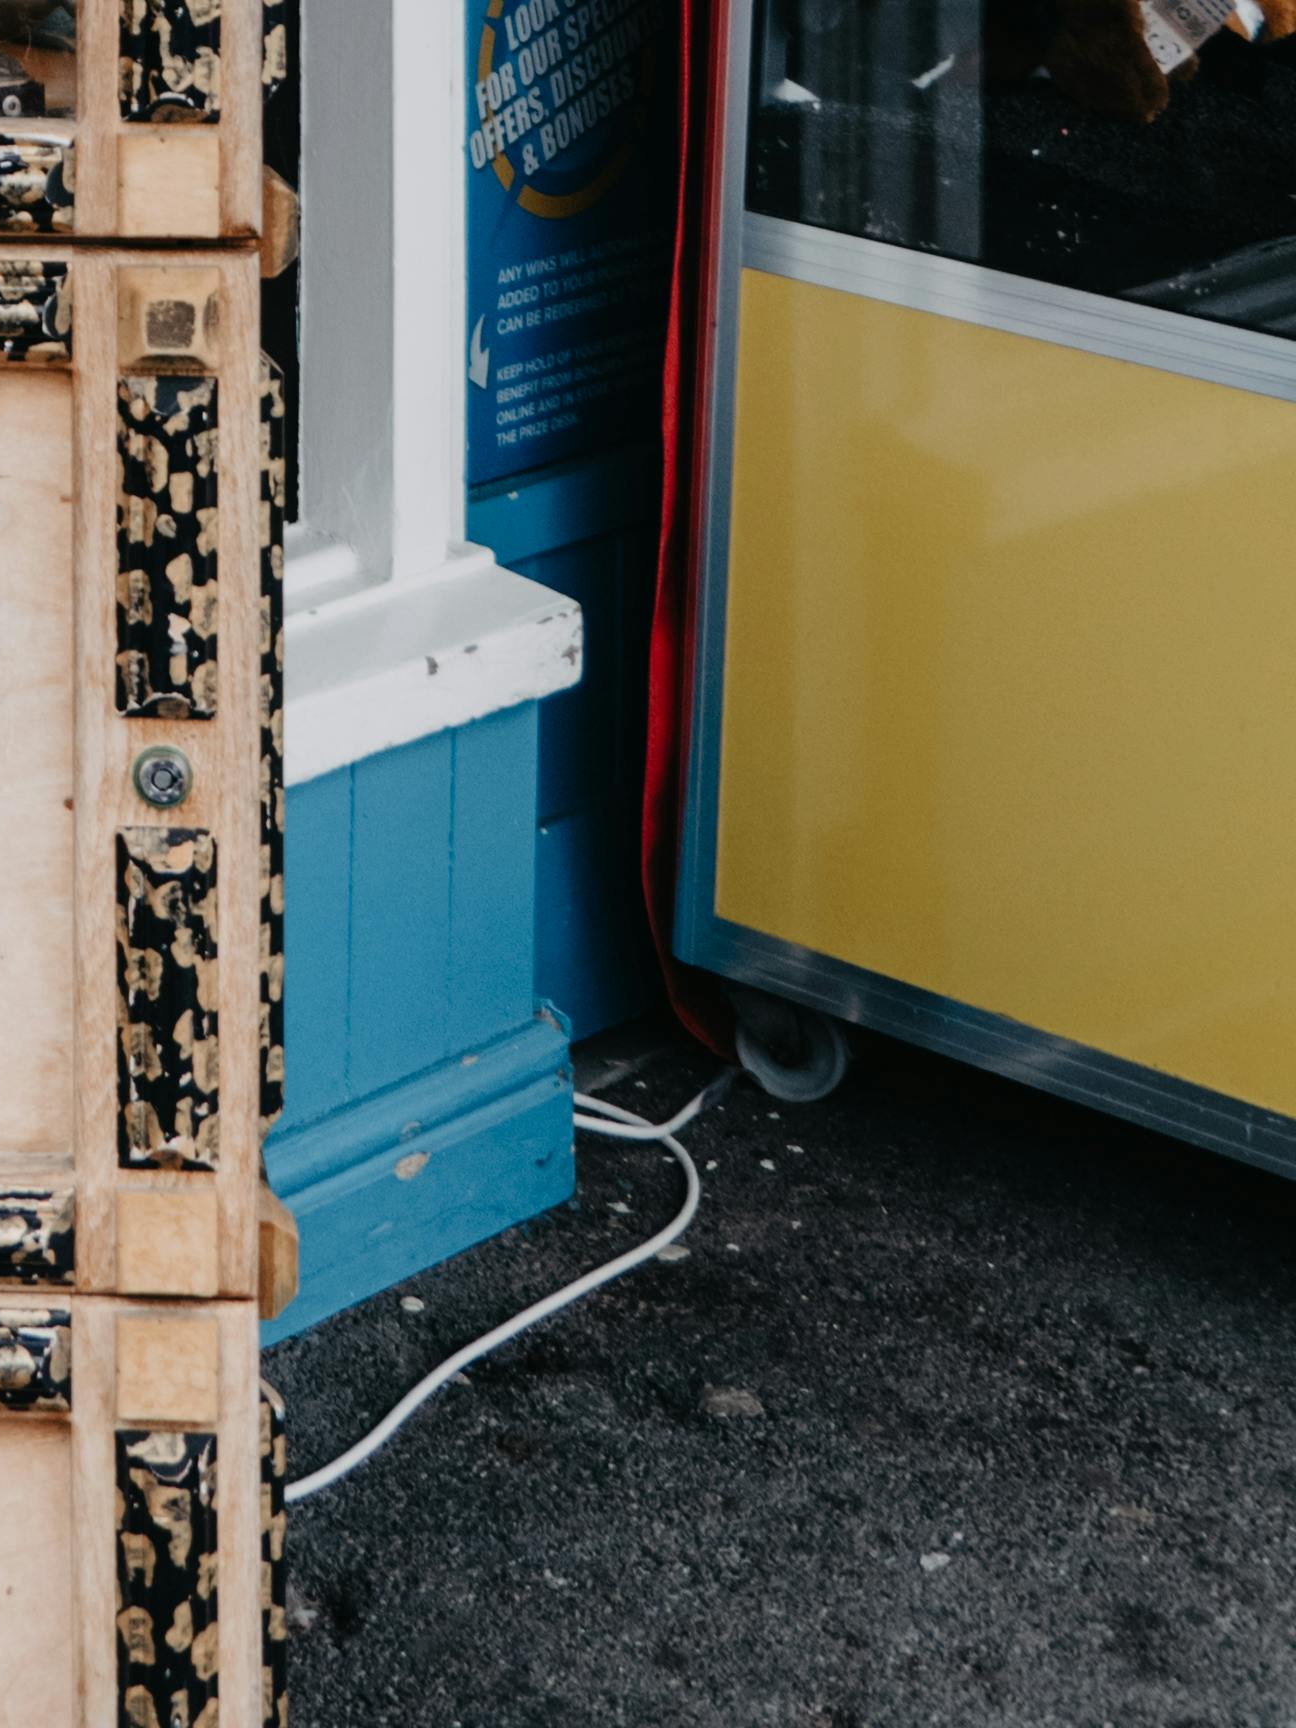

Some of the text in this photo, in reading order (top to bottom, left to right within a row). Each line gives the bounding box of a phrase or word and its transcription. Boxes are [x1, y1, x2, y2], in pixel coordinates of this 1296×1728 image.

[474, 60, 518, 123] FOR
[518, 27, 563, 86] OUR
[521, 63, 635, 176] & BONUSES
[497, 264, 523, 285] ANY
[525, 255, 557, 278] WINS
[497, 285, 539, 311] ADDED
[542, 279, 558, 298] TO
[497, 314, 524, 335] CAN
[525, 308, 542, 327] BE
[496, 362, 524, 382] KEEP
[525, 353, 556, 375] HOLD
[496, 378, 539, 405] BENEFIT
[496, 402, 536, 426] ONLINE
[537, 394, 561, 414] AND
[496, 428, 518, 447] THE
[519, 419, 549, 441] PRIZE
